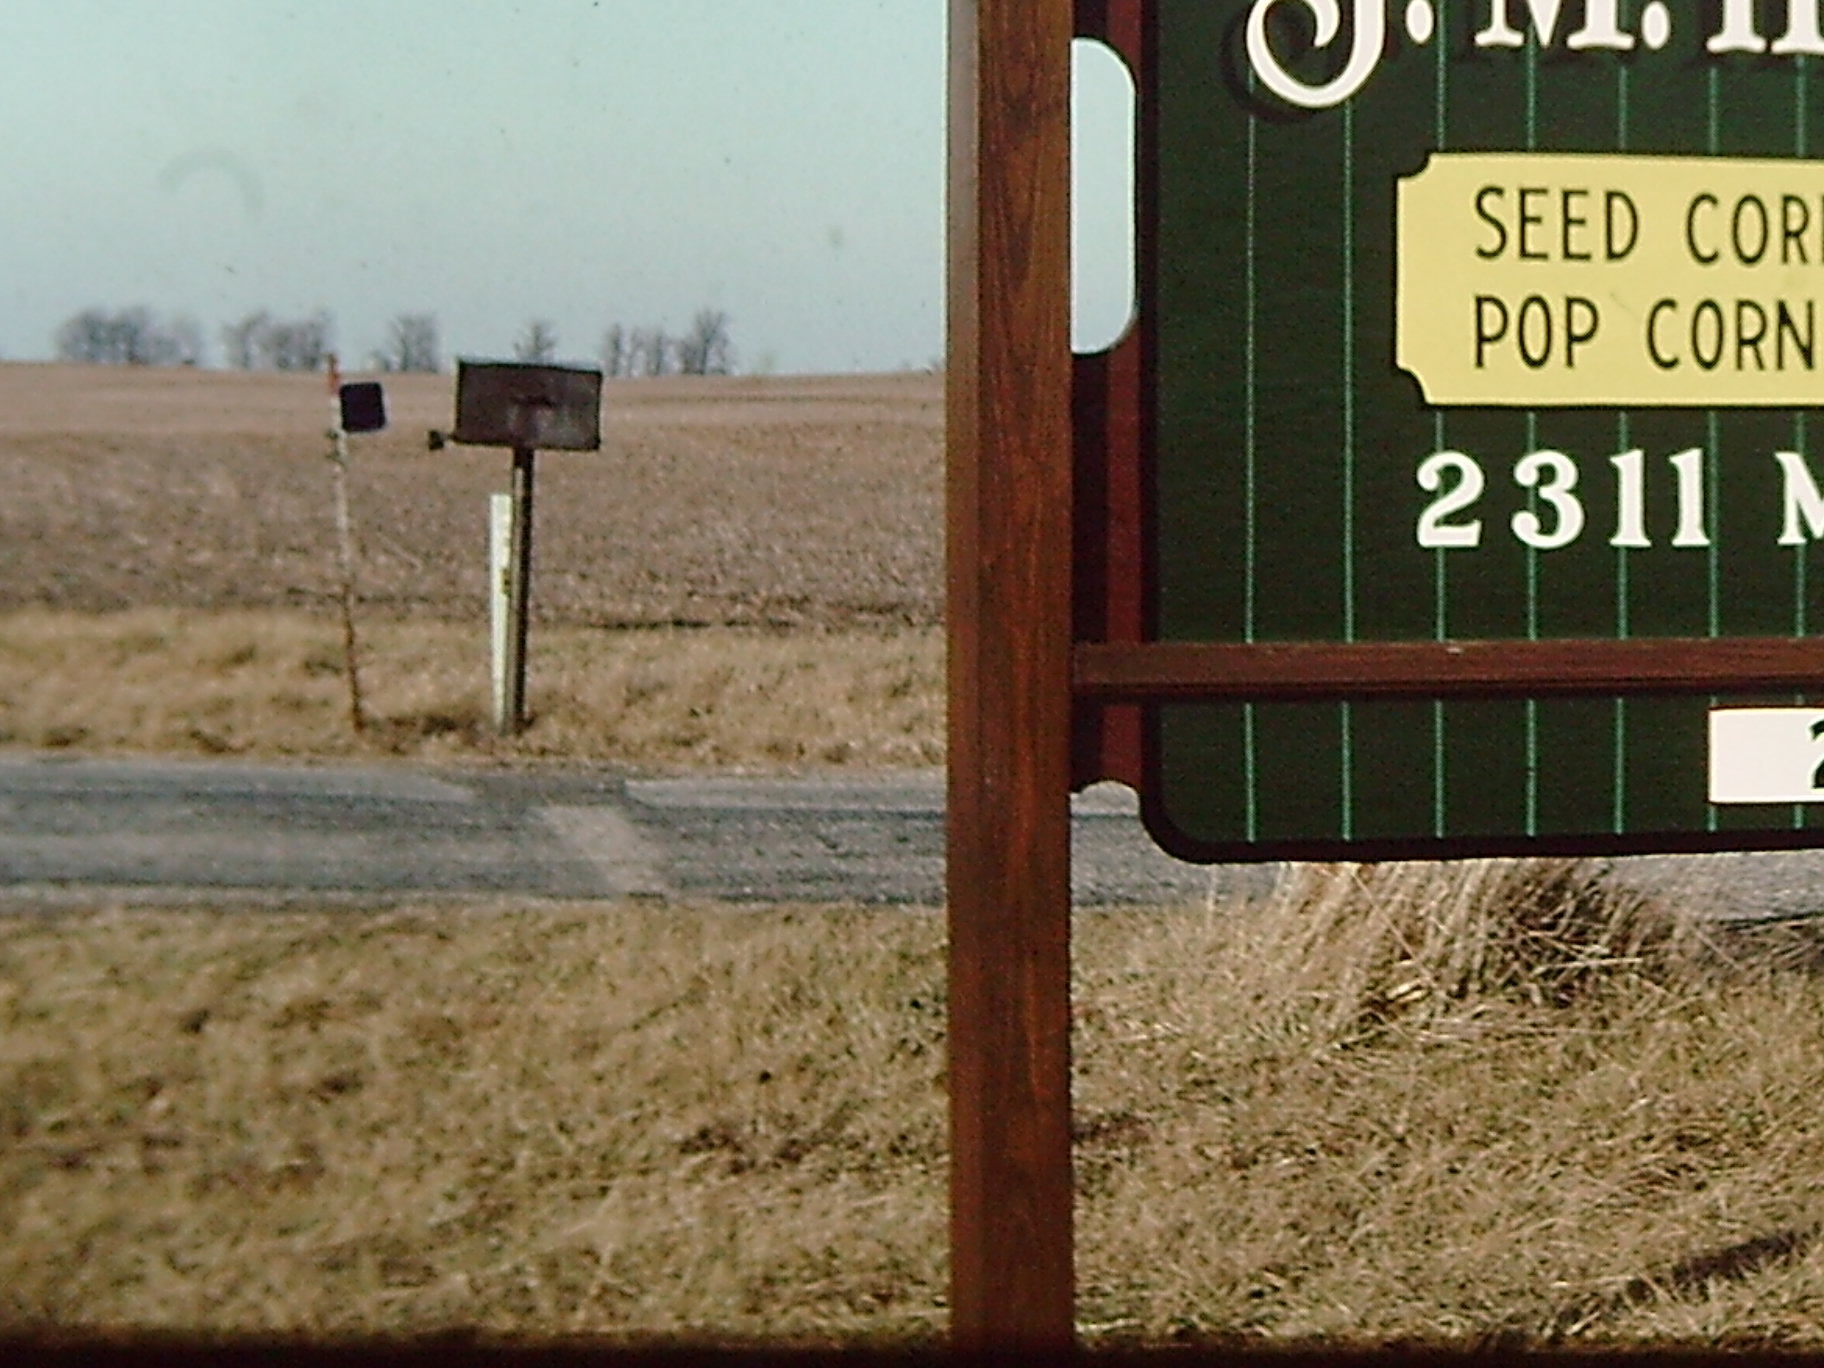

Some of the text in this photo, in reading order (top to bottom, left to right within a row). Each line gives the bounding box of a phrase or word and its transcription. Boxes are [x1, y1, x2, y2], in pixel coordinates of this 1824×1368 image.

[1475, 186, 1638, 261] SEED
[1475, 295, 1600, 369] POP
[1647, 298, 1815, 371] CORN
[1418, 449, 1710, 548] 2311
